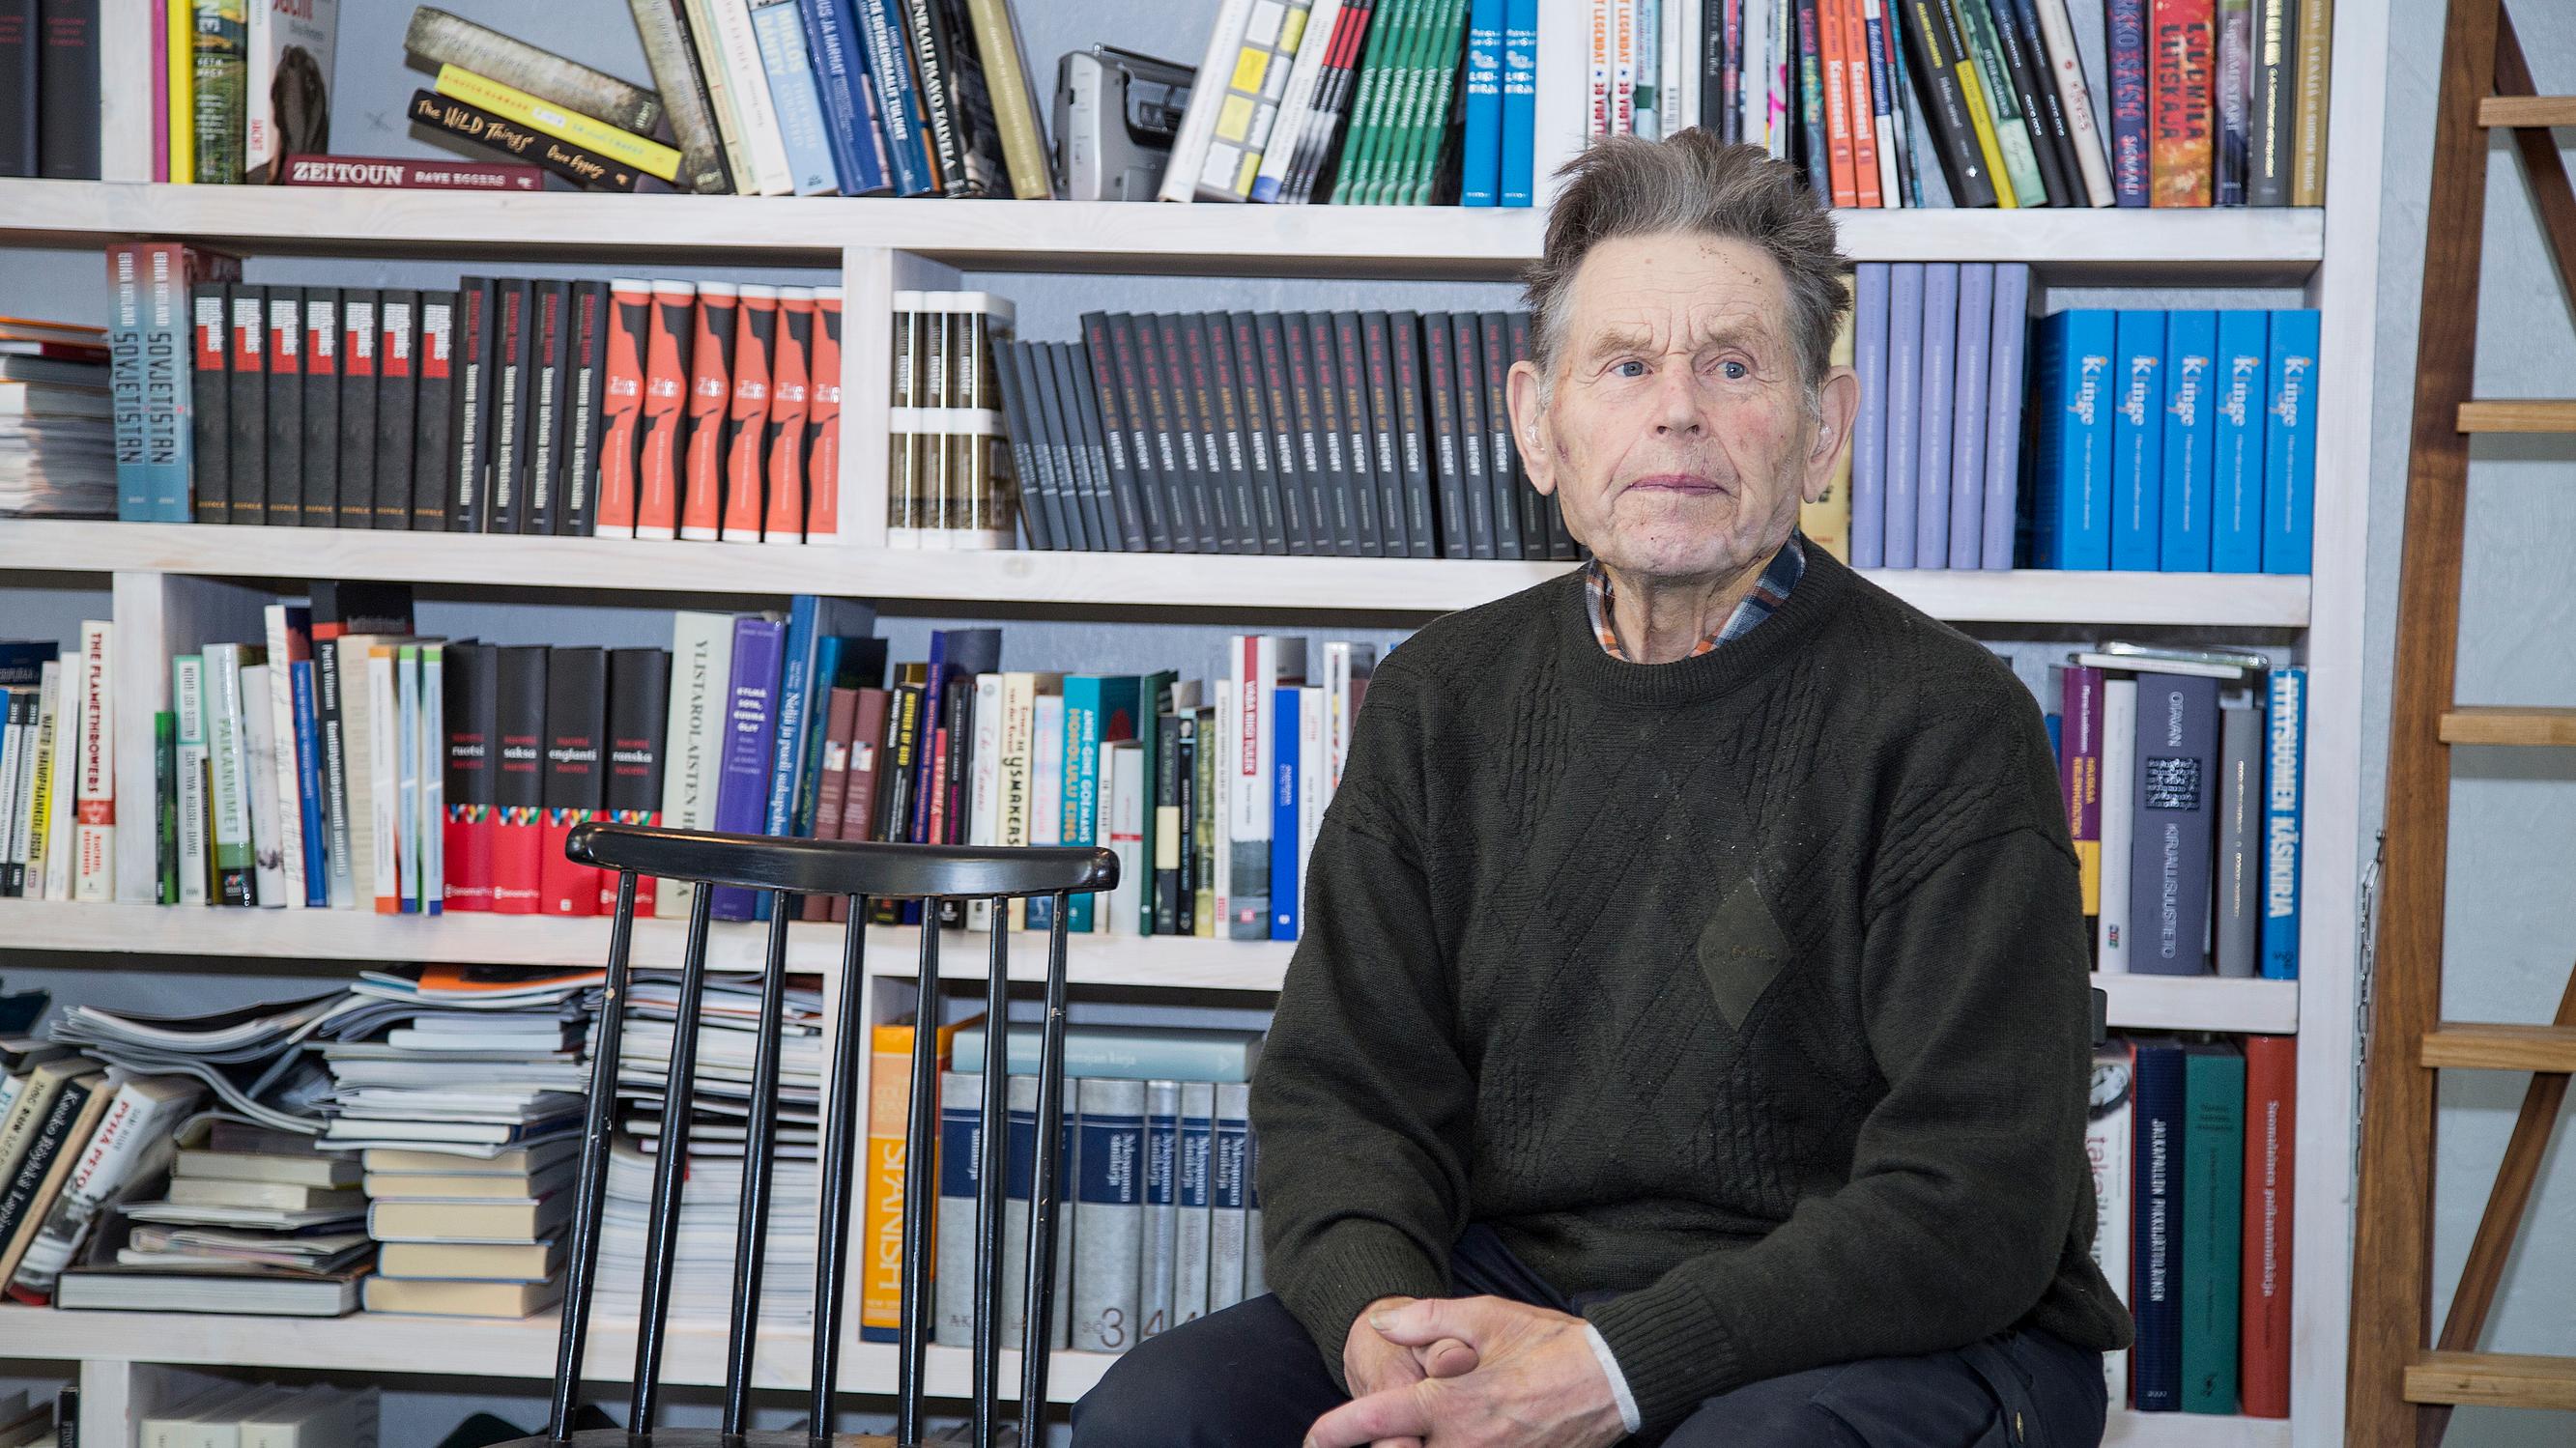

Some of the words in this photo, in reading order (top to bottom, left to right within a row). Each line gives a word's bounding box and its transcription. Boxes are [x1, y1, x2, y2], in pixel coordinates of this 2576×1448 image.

[819, 18, 834, 34] JA
[823, 34, 845, 75] HARHAT
[924, 60, 945, 107] PAAVO
[1829, 60, 1848, 139] Karanteeni
[1851, 62, 1872, 139] Karanteeni
[2159, 25, 2182, 140] ULITSKAJA
[2186, 22, 2207, 140] LJUDMILA
[417, 99, 442, 120] The
[486, 123, 534, 153] Things
[889, 99, 908, 140] TULIVAT
[931, 107, 957, 170] TALVELA
[294, 161, 403, 186] ZEITOUN
[415, 169, 450, 185] DAVE
[547, 145, 570, 164] Dave
[113, 330, 145, 466] SOVJETISTAN
[147, 330, 176, 466] SOVJETISTAN
[1109, 432, 1125, 470] HISTORY
[1133, 431, 1150, 470] HISTORY
[1159, 432, 1174, 471] HISTORY
[1183, 432, 1198, 470] HISTORY
[1205, 433, 1219, 472] HISTORY
[1227, 432, 1242, 470] HISTORY
[1252, 432, 1267, 471] HISTORY
[1277, 435, 1293, 473] HISTORY
[1302, 433, 1317, 471] HISTORY
[1328, 433, 1341, 471] HISTORY
[1352, 434, 1366, 473] HISTORY
[1379, 433, 1392, 472] HISTORY
[1406, 433, 1420, 472] HISTORY
[1441, 436, 1454, 475] HISTORY
[1467, 437, 1481, 476] HISTORY
[1495, 433, 1507, 472] HISTORY
[90, 633, 101, 659] THE
[87, 666, 100, 793] FLAMETHROWERS
[683, 639, 709, 805] YLISTAROLAISTEN
[2168, 692, 2184, 747] OTAVAN
[504, 749, 536, 760] saksa
[550, 749, 597, 762] englanti
[777, 739, 793, 772] puoli
[1066, 708, 1080, 798] HONOLULU
[2271, 676, 2299, 811] NYKYSUOMEN
[216, 718, 239, 834] PAIKANNIMET
[186, 832, 198, 856] DAVID
[1064, 802, 1077, 842] KING
[2269, 816, 2299, 918] KÄSIKIRJA
[2161, 823, 2178, 959] KIRJALLISUUSTIETO
[46, 1089, 78, 1136] Kauko
[100, 1097, 130, 1146] PYHÄ
[16, 1132, 55, 1189] Röyhkä
[1106, 1134, 1122, 1186] sanakirja
[1182, 1137, 1193, 1189] sanakirja
[1215, 1137, 1230, 1189] sanakirja
[2151, 1118, 2167, 1195] JALKAPALLON
[2265, 1099, 2279, 1187] Suomalainen
[76, 1149, 103, 1191] PETO
[1121, 1131, 1136, 1203] Nykysuomen
[1194, 1135, 1210, 1206] Nykysuomen
[1230, 1136, 1245, 1207] Nykysuomen
[878, 1144, 904, 1291] SPANISH
[2149, 1198, 2167, 1302] PIKKUJÄTTILÄINEN
[2261, 1188, 2278, 1296] paikannimikirja
[1100, 1308, 1125, 1349] 3
[1144, 1309, 1163, 1337] 4
